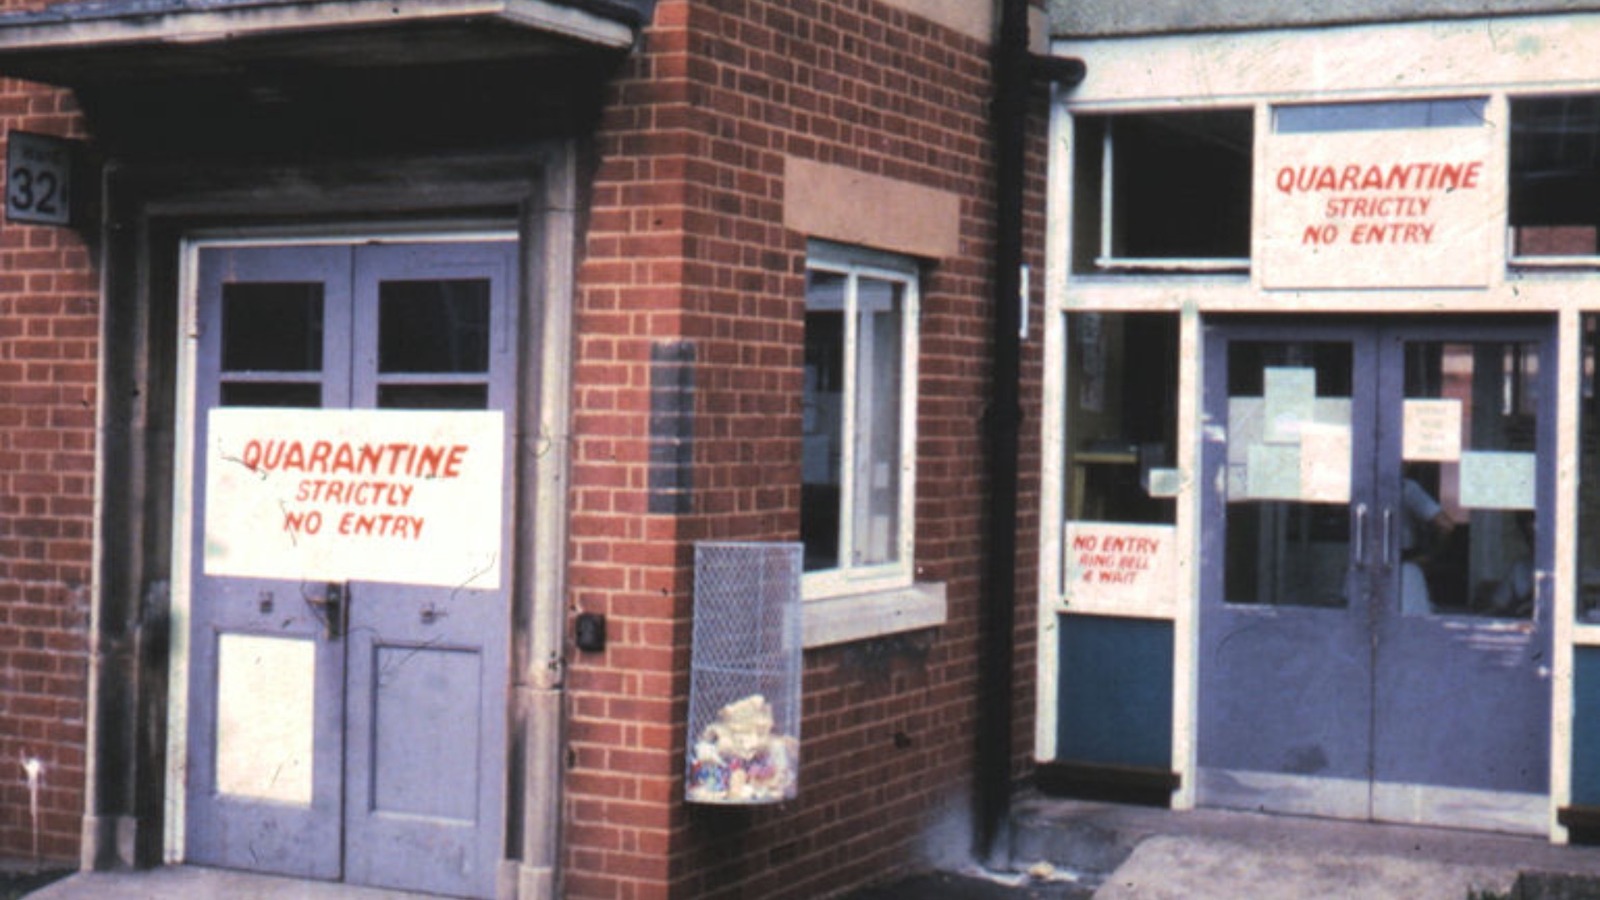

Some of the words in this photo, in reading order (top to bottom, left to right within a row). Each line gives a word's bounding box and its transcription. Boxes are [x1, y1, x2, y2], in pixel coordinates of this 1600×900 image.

[12, 168, 57, 214] 32
[1276, 162, 1482, 194] QUARANTINE
[1326, 196, 1430, 218] STRICTLY
[1302, 224, 1338, 244] NO
[1350, 224, 1435, 244] ENTRY
[243, 439, 469, 478] QUARANTINE
[296, 479, 413, 506] STRICTLY
[283, 510, 322, 535] NO
[338, 512, 423, 539] ENTRY
[1073, 535, 1098, 551] NO
[1103, 536, 1159, 554] ENTRY
[1099, 571, 1136, 584] WAIT
